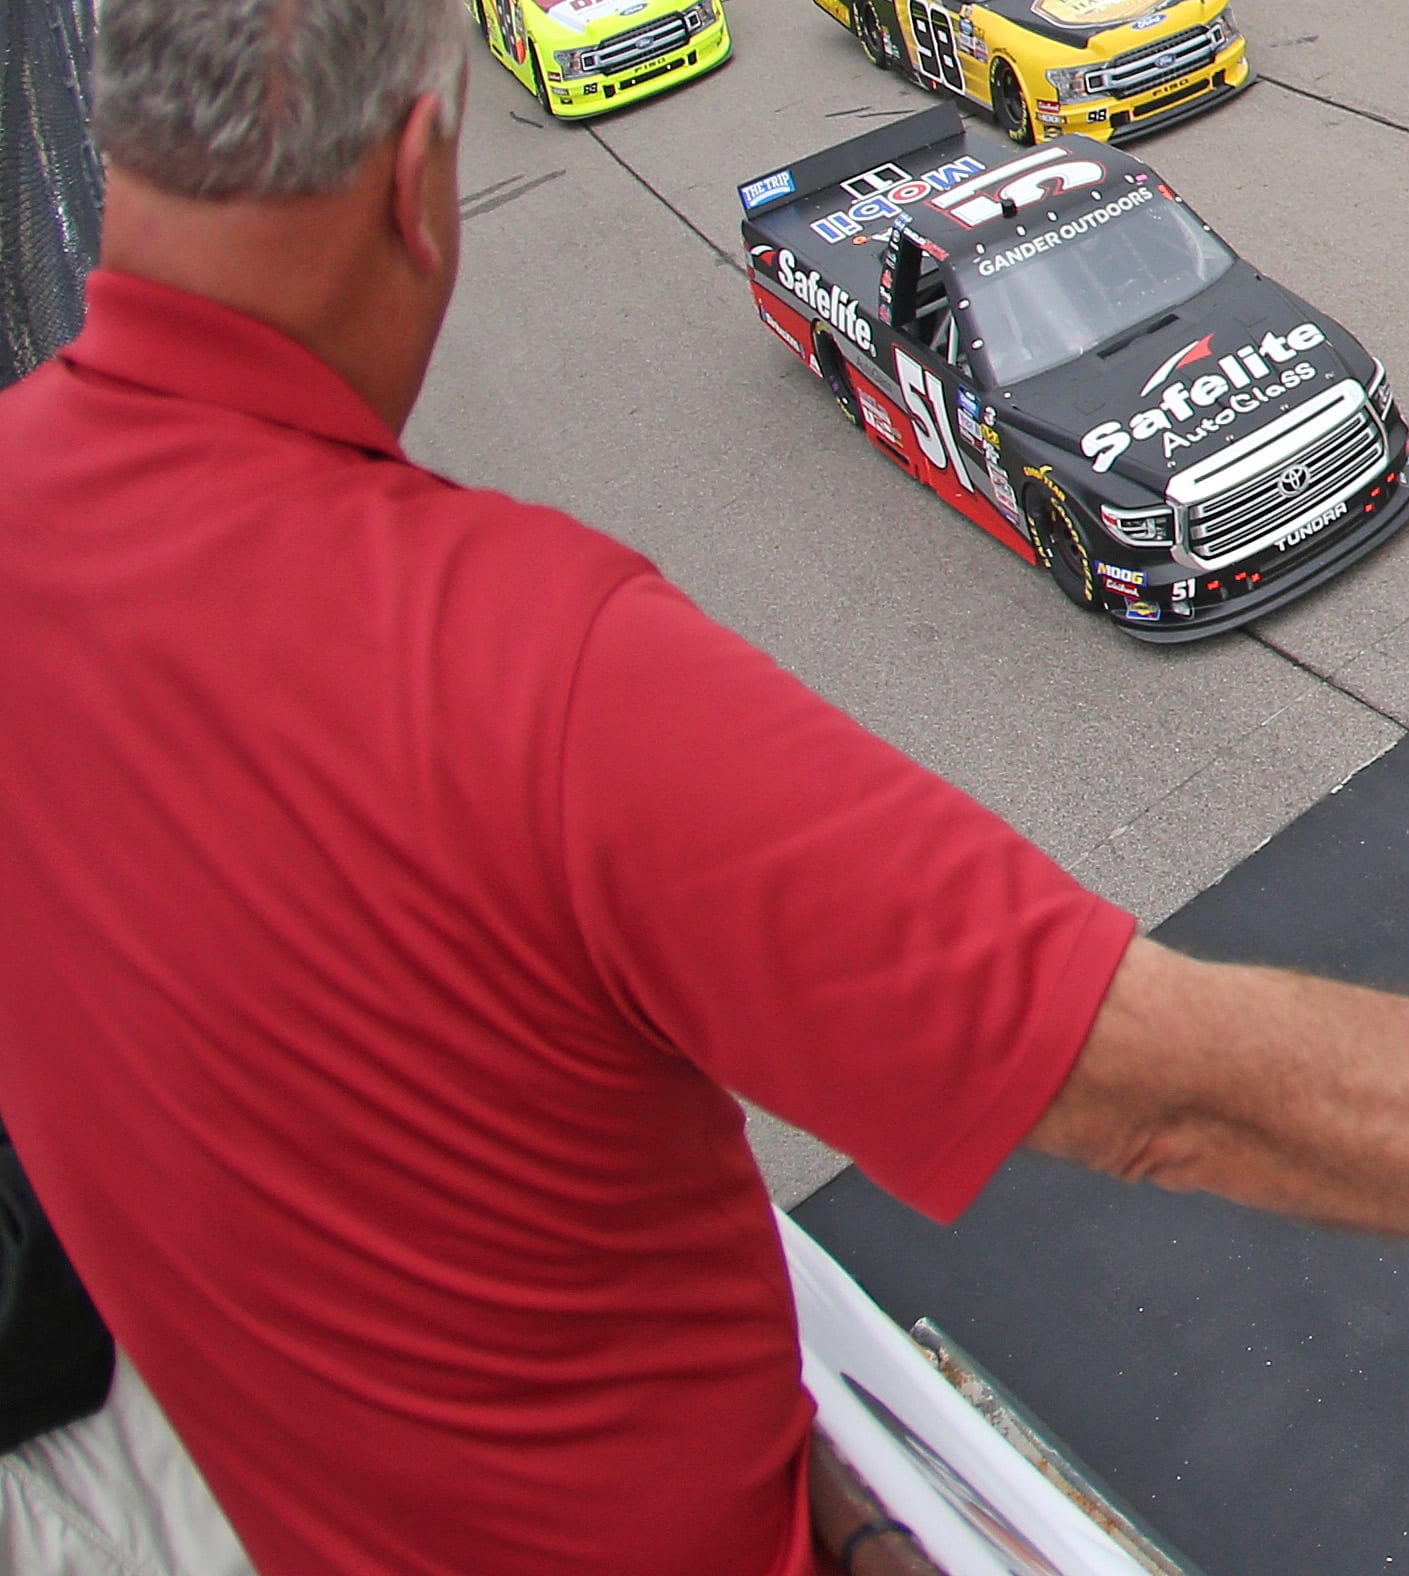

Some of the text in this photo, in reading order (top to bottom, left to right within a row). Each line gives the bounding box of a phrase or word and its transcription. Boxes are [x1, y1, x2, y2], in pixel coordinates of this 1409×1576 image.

[1087, 108, 1109, 123] 98
[741, 172, 791, 202] THE TRIP
[810, 155, 986, 245] Mobil
[978, 230, 1060, 277] GANDER
[1060, 187, 1153, 239] OUTDOORS
[777, 248, 875, 355] Safelite
[893, 345, 976, 494] 51
[1081, 323, 1327, 474] Safelite
[1161, 361, 1317, 460] AutoGlass
[1273, 501, 1349, 553] TUNDRA
[1097, 562, 1146, 586] MOOG
[1172, 578, 1197, 601] 51
